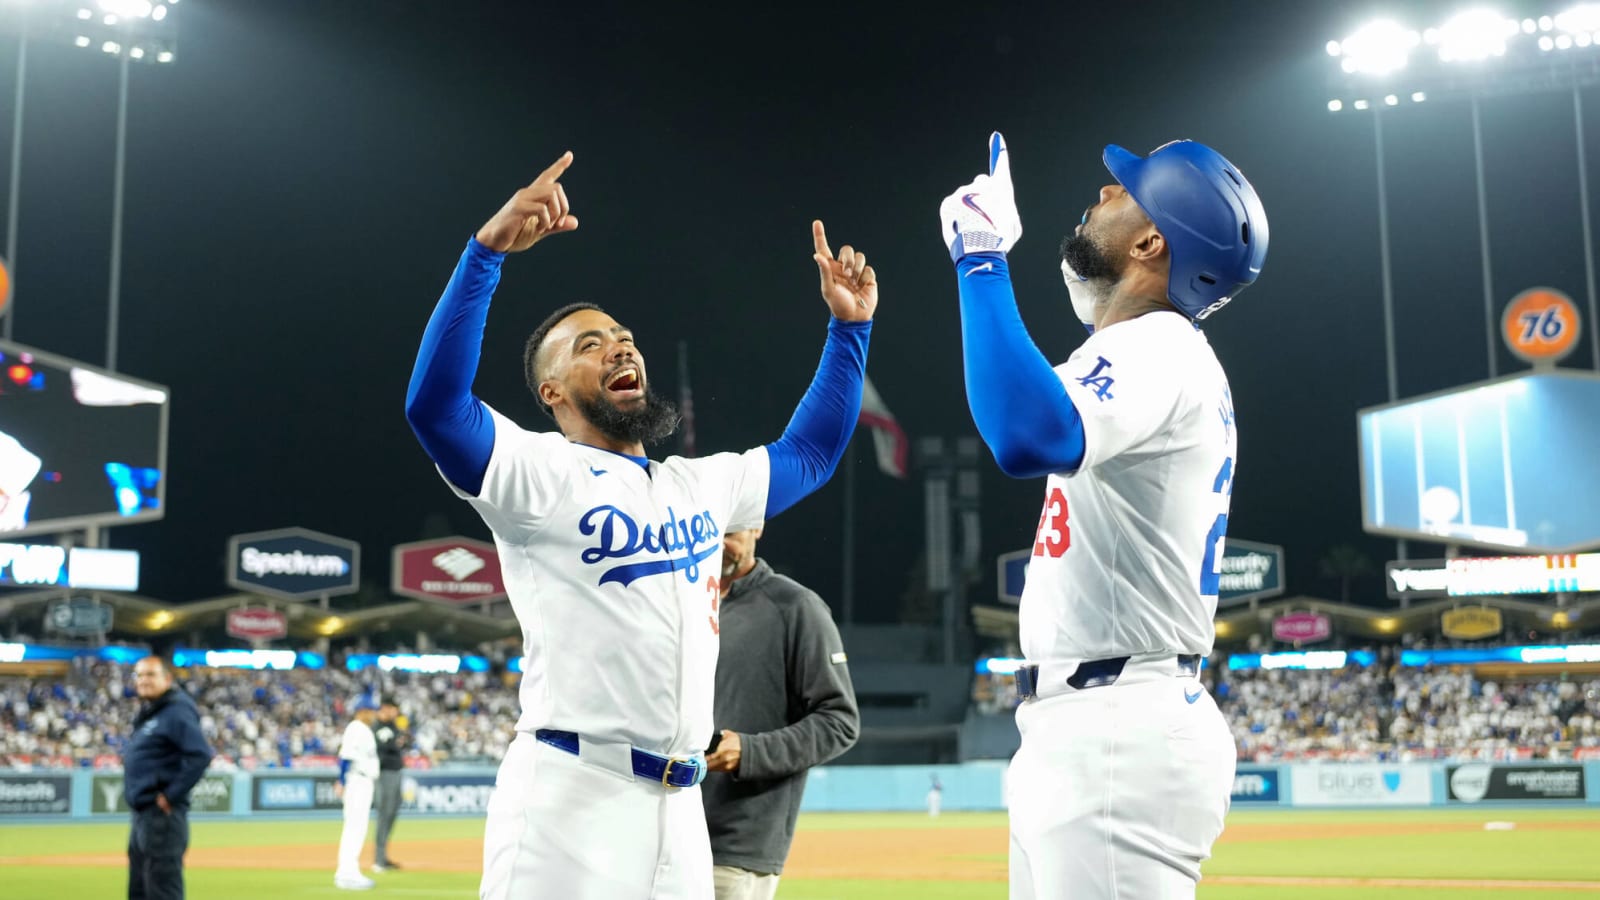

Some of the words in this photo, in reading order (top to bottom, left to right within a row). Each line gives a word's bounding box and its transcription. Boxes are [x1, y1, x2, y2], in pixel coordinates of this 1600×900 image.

[1518, 305, 1567, 345] 76
[1075, 355, 1114, 402] LA
[241, 547, 344, 577] Spectrum
